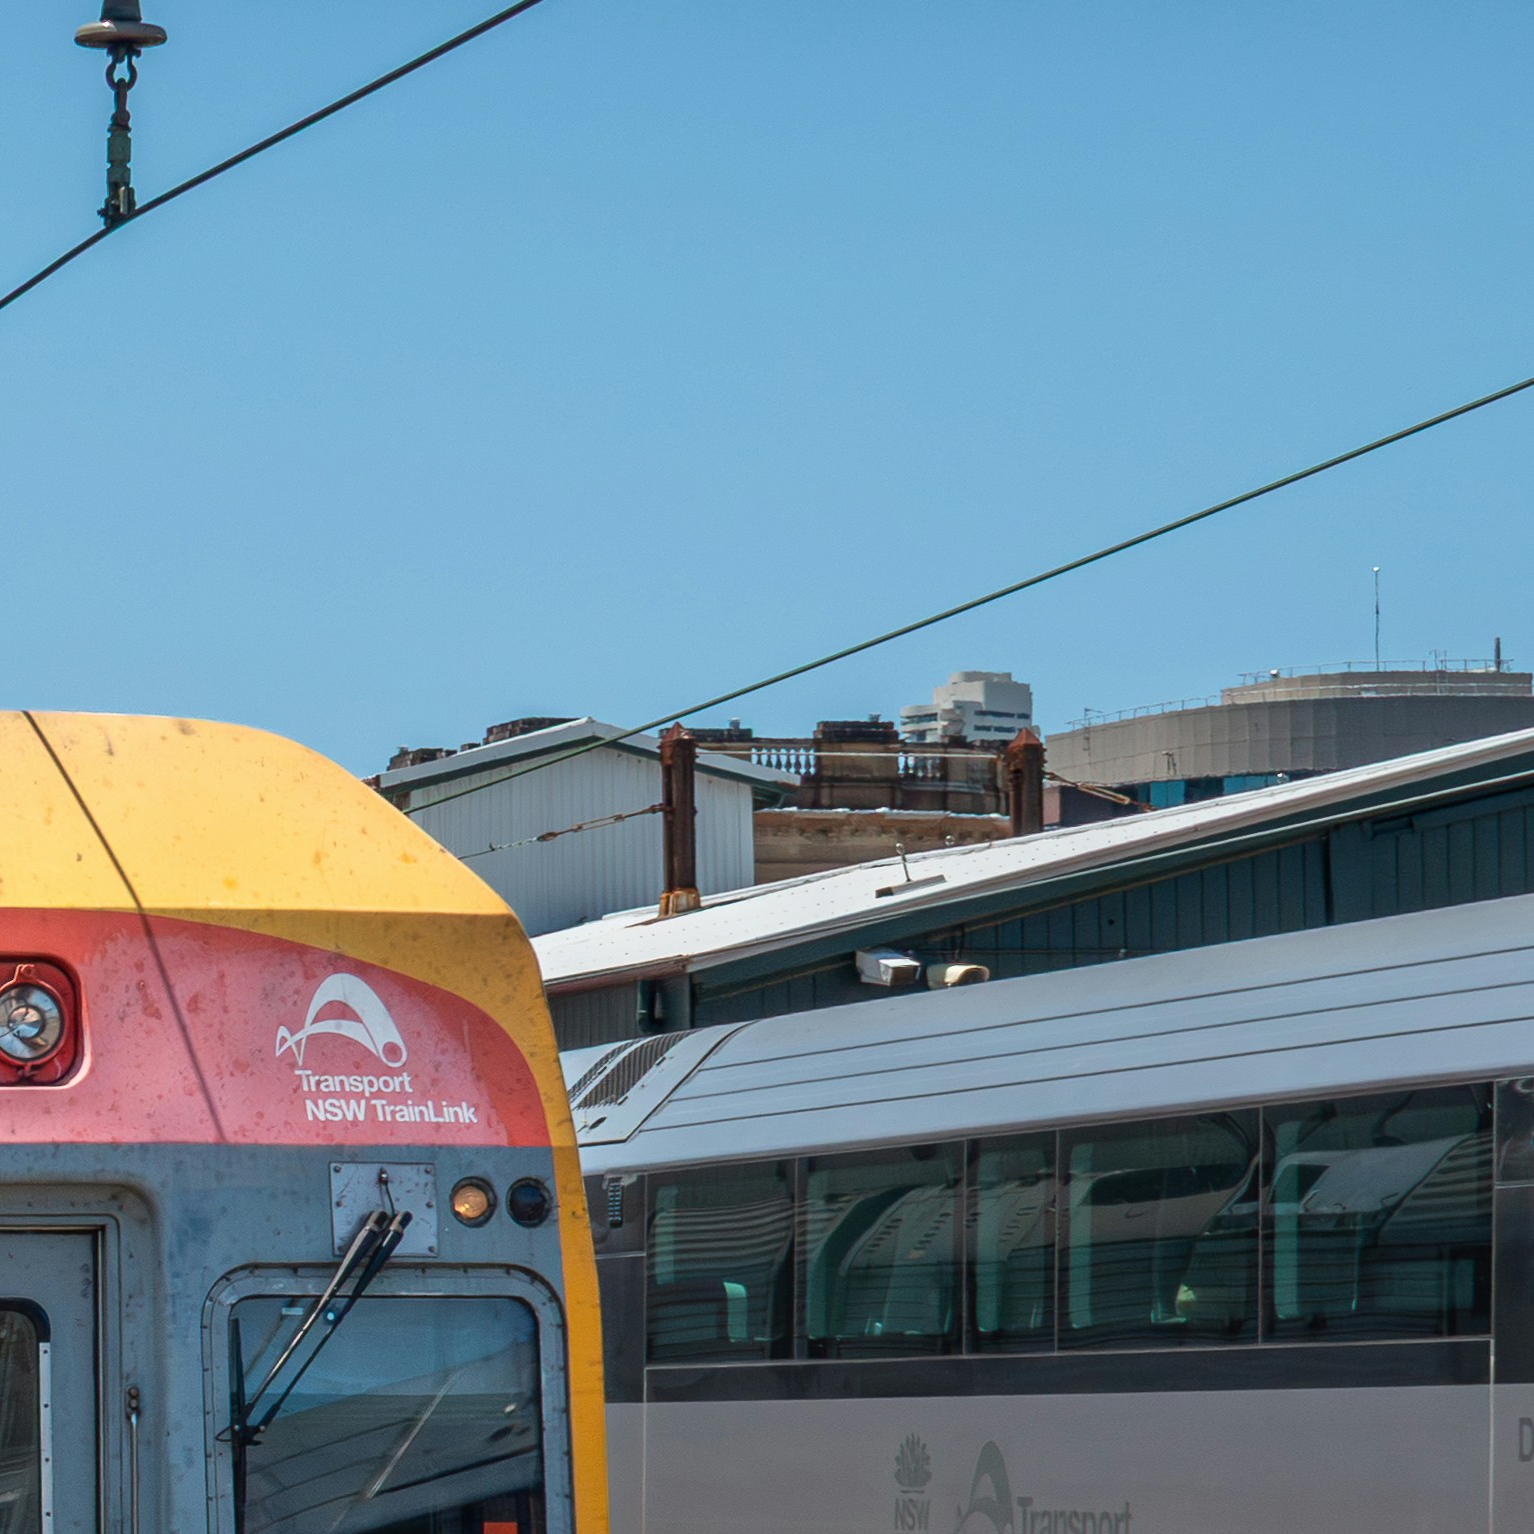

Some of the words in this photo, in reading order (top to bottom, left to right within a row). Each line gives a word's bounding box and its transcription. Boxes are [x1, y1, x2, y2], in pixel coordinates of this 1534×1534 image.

[294, 1070, 413, 1097] Transport
[305, 1099, 366, 1121] NSW
[370, 1100, 478, 1123] TrainLink
[894, 1498, 931, 1531] NSW
